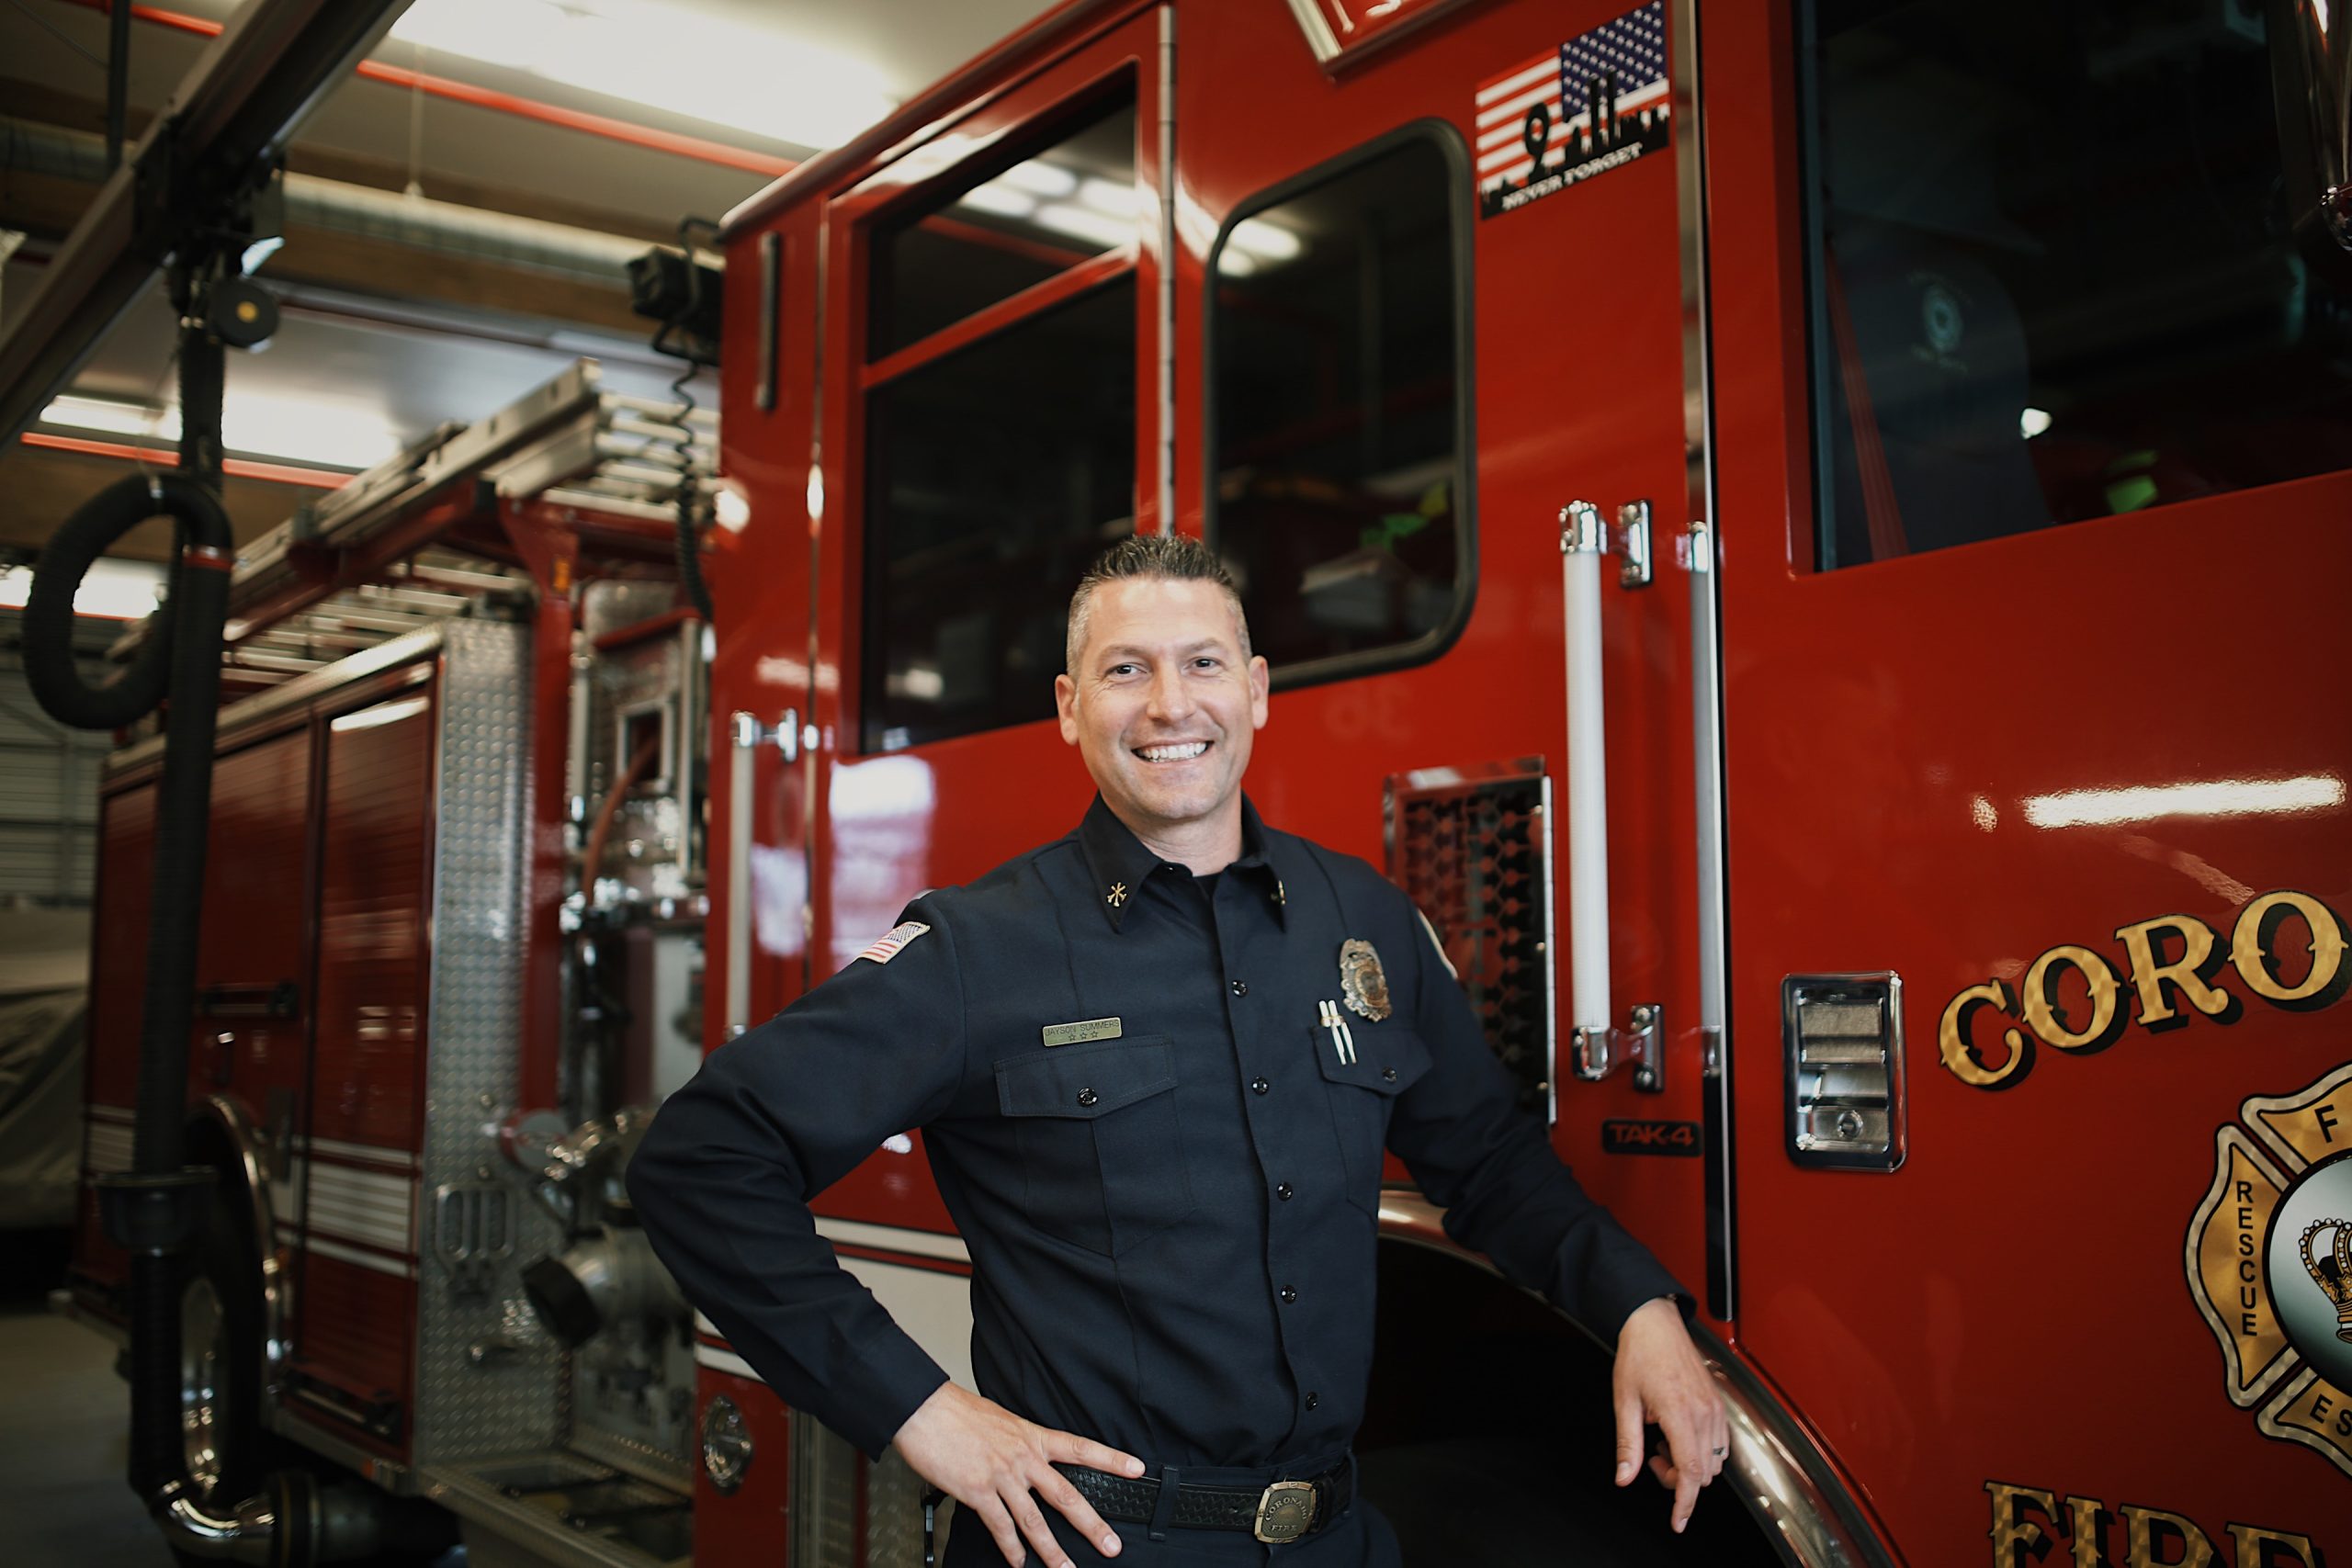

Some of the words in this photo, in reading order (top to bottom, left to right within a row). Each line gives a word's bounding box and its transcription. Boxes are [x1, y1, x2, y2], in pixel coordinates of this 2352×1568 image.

[1502, 175, 1562, 210] NEVER
[1564, 141, 1643, 186] FORGET
[1046, 1026, 1077, 1036] JAYSON
[1080, 1021, 1119, 1032] SUMMERS
[1939, 889, 2352, 1089] CORO
[2235, 1179, 2258, 1337] RESCUE
